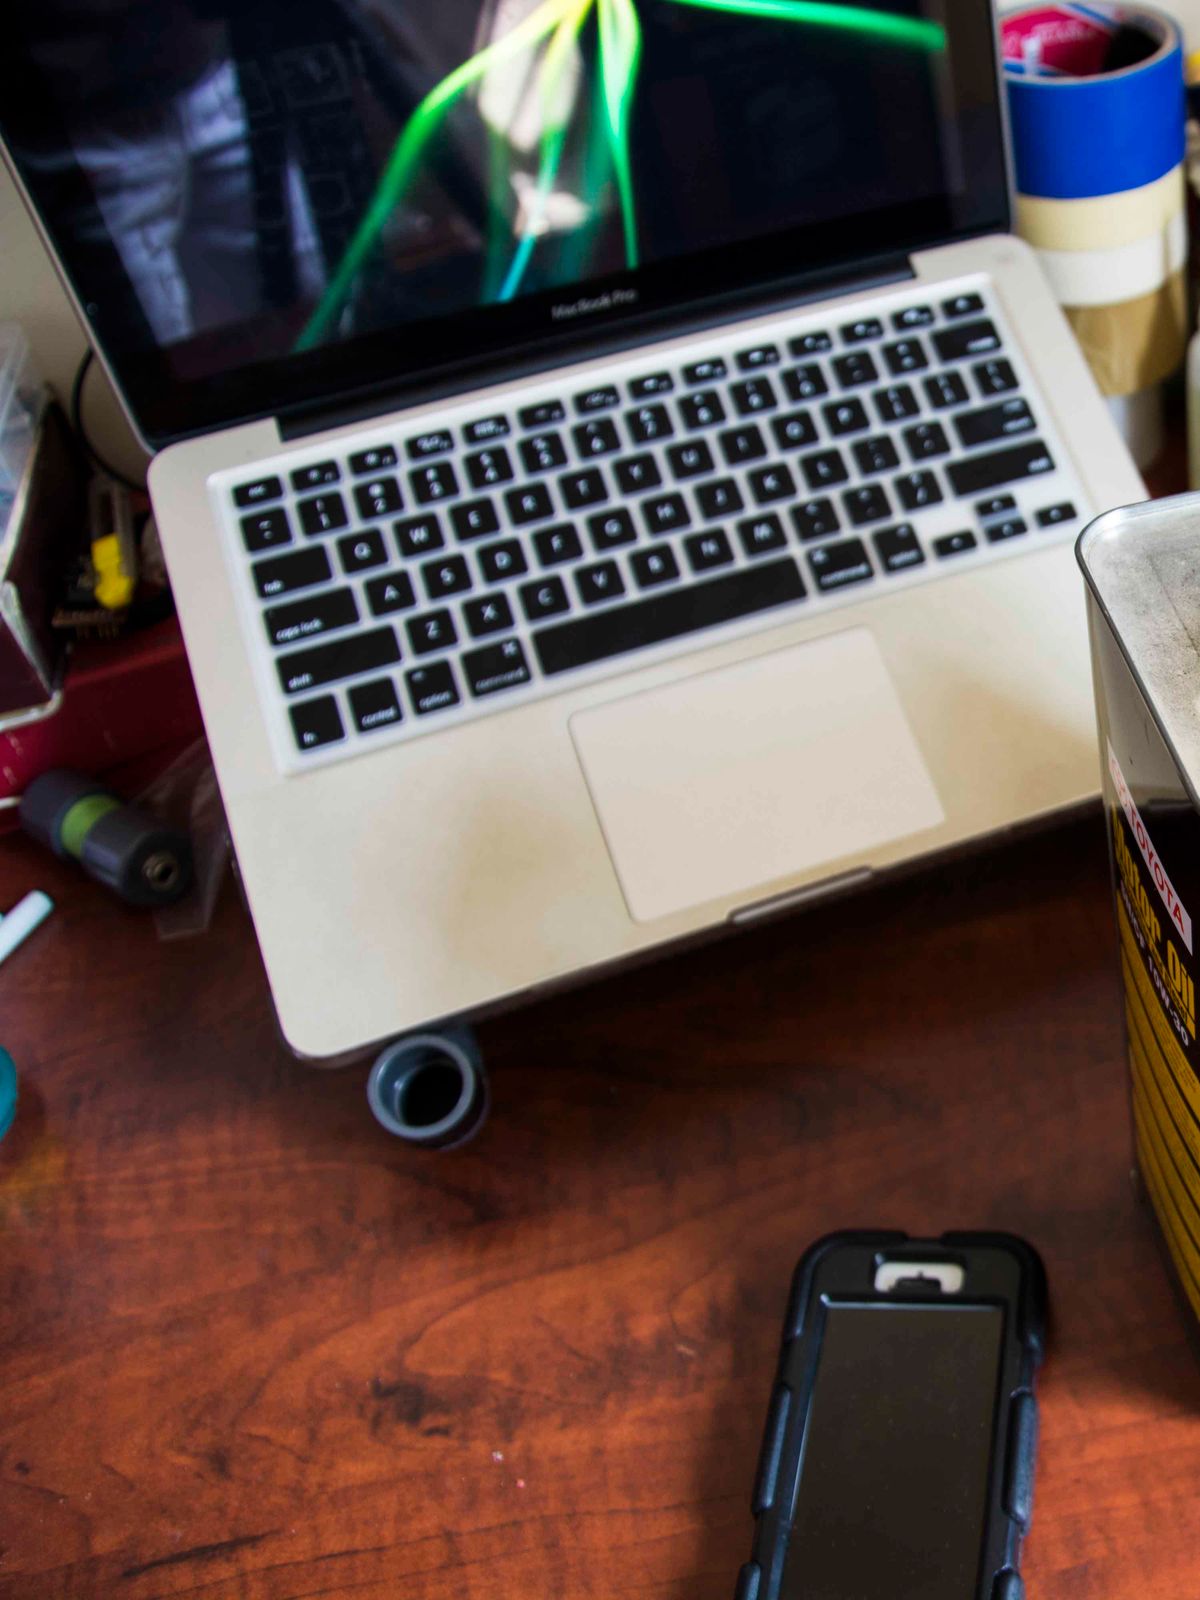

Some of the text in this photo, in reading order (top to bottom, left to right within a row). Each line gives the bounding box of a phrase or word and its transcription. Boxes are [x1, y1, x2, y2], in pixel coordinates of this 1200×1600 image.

[551, 288, 638, 319] MacBook Pro
[475, 666, 528, 691] command
[361, 705, 397, 727] control
[419, 690, 453, 711] option
[1129, 800, 1185, 935] TOYOTA
[1167, 939, 1195, 1023] Oil
[1148, 955, 1189, 1047] 10W-30
